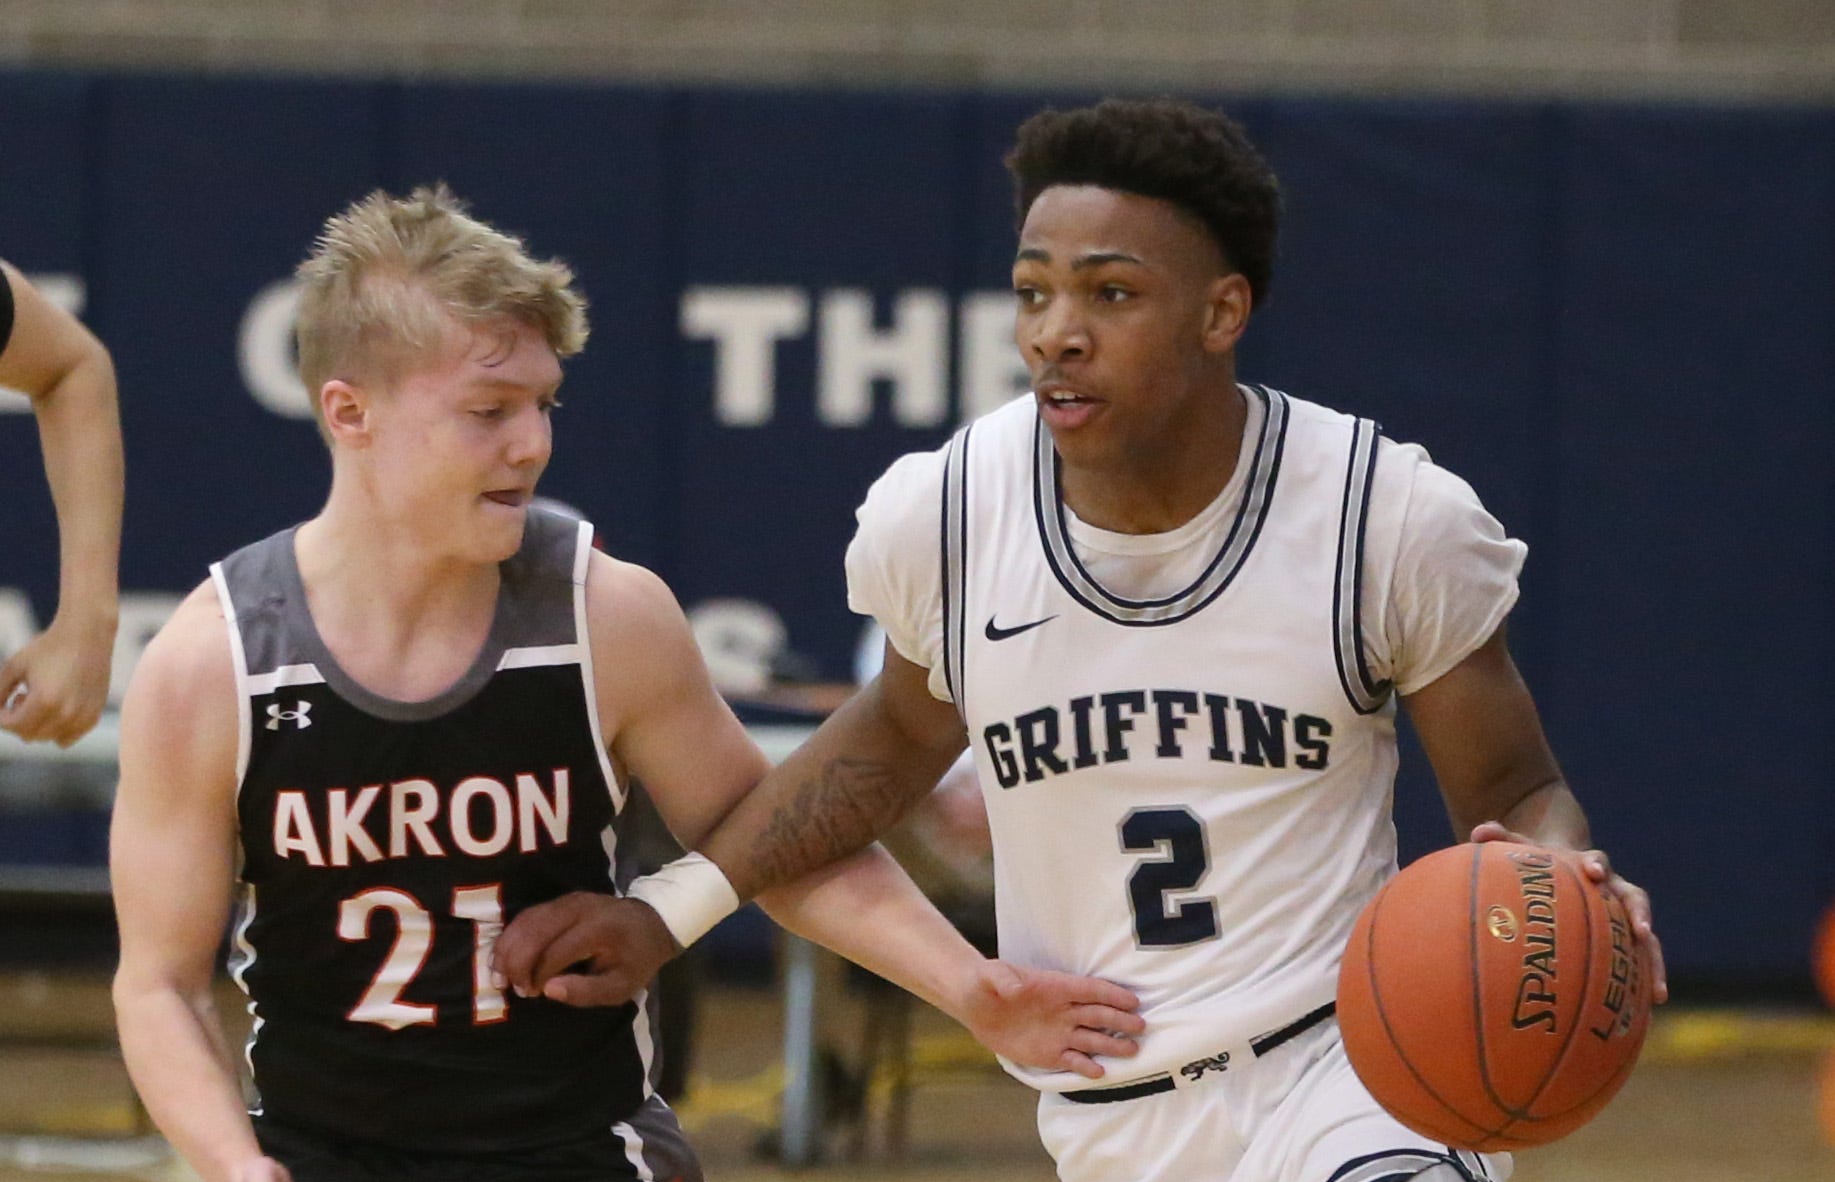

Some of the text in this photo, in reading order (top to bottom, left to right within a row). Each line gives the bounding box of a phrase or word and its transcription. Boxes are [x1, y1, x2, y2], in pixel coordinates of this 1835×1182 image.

[984, 688, 1333, 790] GRIFFINS
[272, 767, 571, 868] AKRON
[1116, 803, 1223, 952] 2
[336, 882, 510, 1031] 21
[1507, 852, 1558, 1035] SPALDING
